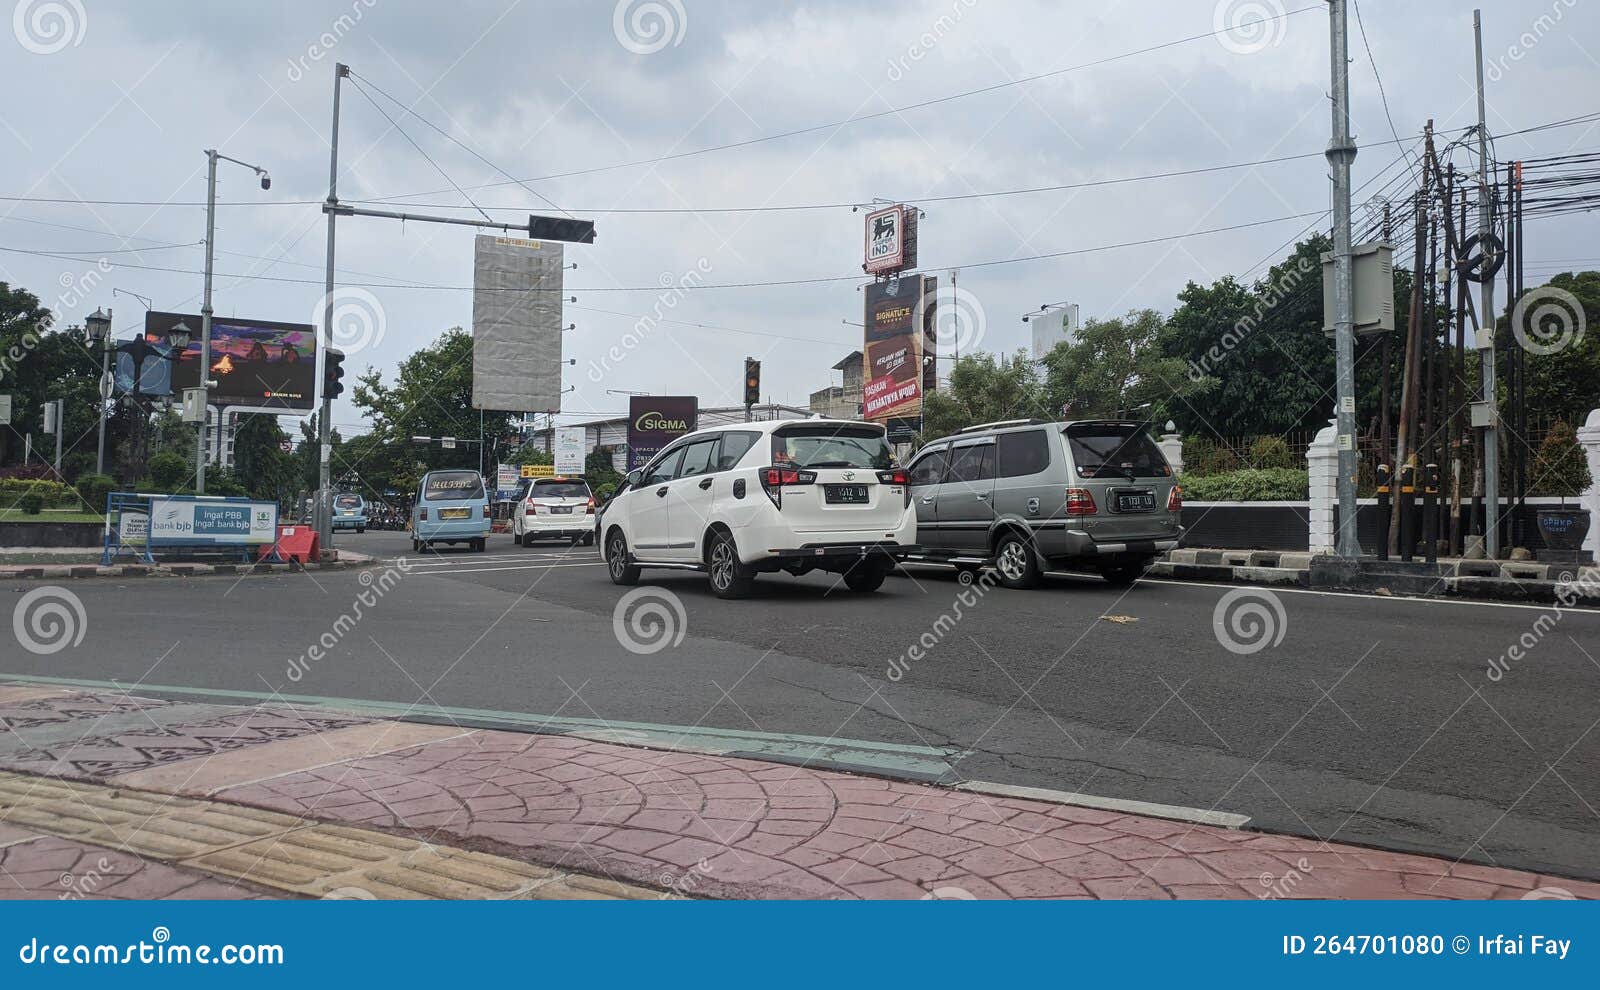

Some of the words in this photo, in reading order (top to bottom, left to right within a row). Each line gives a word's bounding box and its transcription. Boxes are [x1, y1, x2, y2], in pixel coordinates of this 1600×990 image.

[645, 419, 687, 430] SIGMA
[204, 511, 224, 520] Ingat
[225, 511, 242, 519] PBB
[153, 521, 175, 530] bank
[176, 521, 191, 532] bjb
[195, 520, 215, 529] Ingat
[236, 521, 250, 530] bjb
